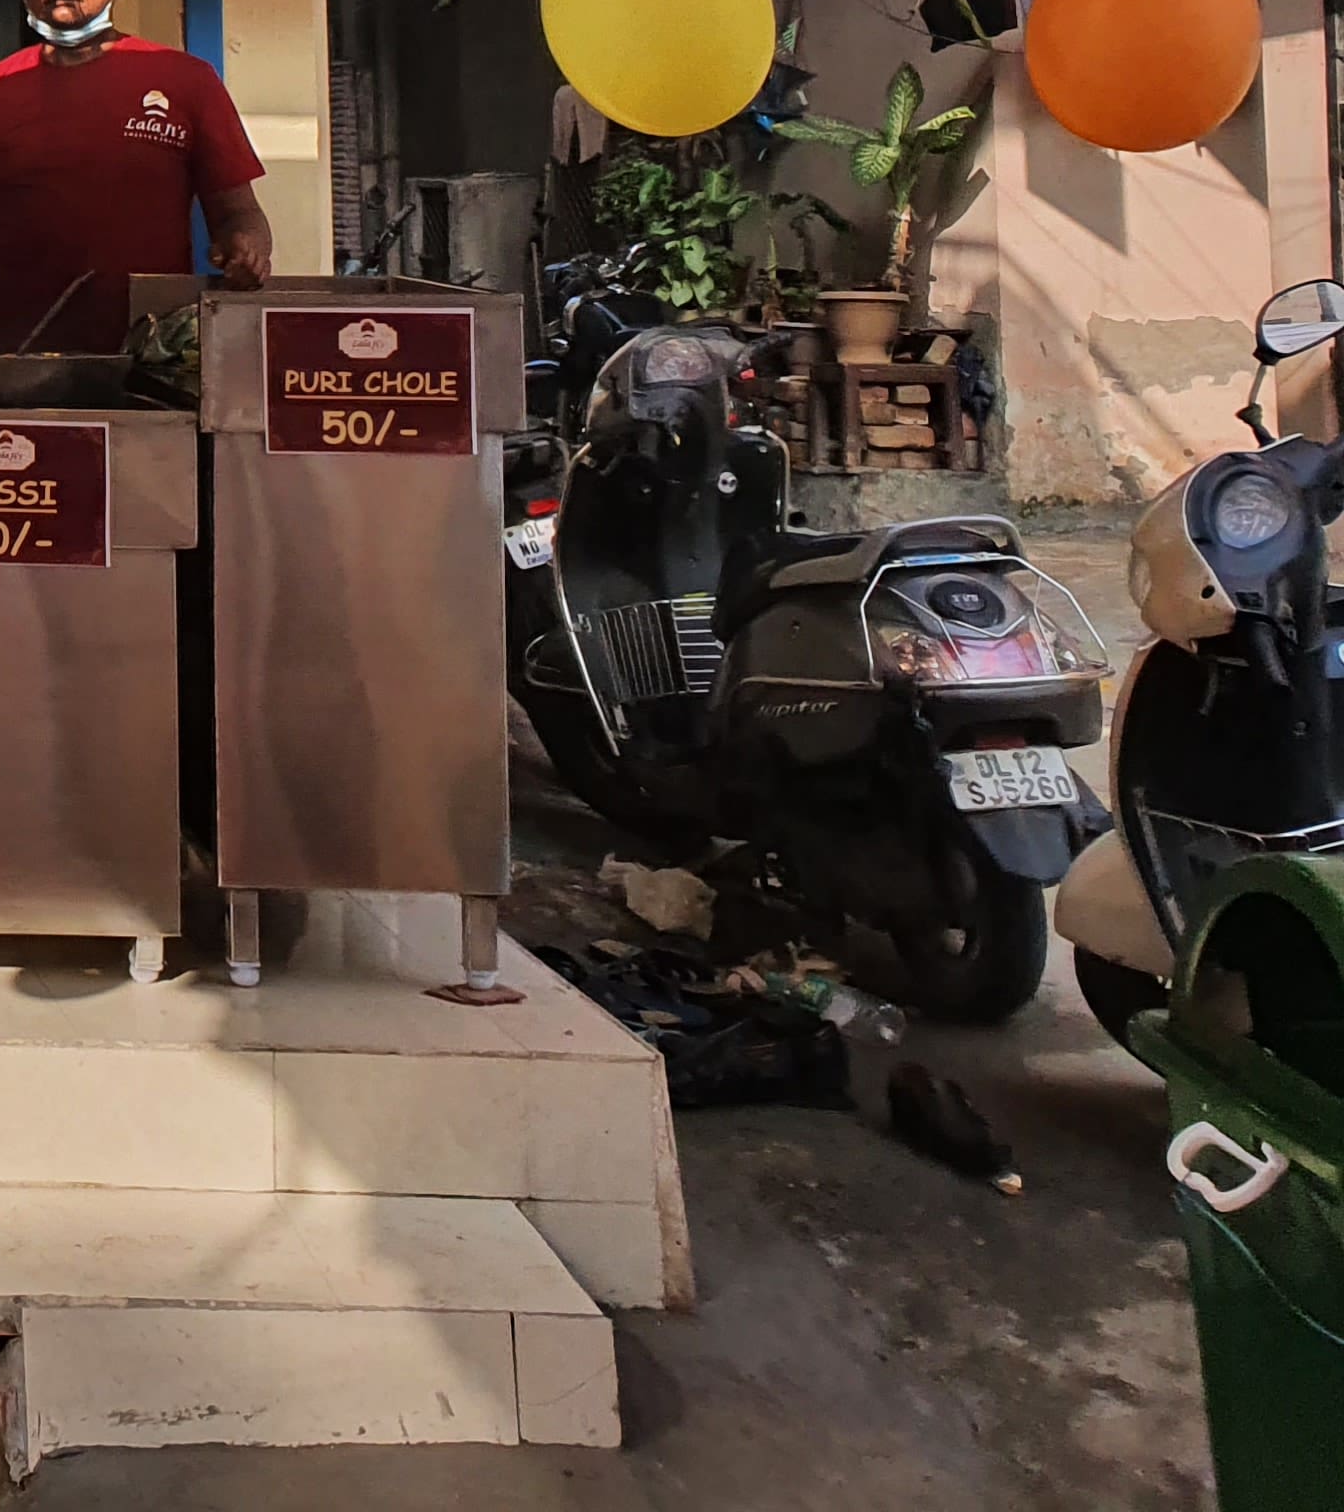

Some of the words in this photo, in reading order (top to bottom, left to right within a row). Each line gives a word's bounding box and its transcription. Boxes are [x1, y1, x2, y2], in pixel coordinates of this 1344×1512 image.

[283, 369, 353, 393] PURI
[363, 370, 459, 396] CHOLE
[321, 408, 419, 446] 50/-
